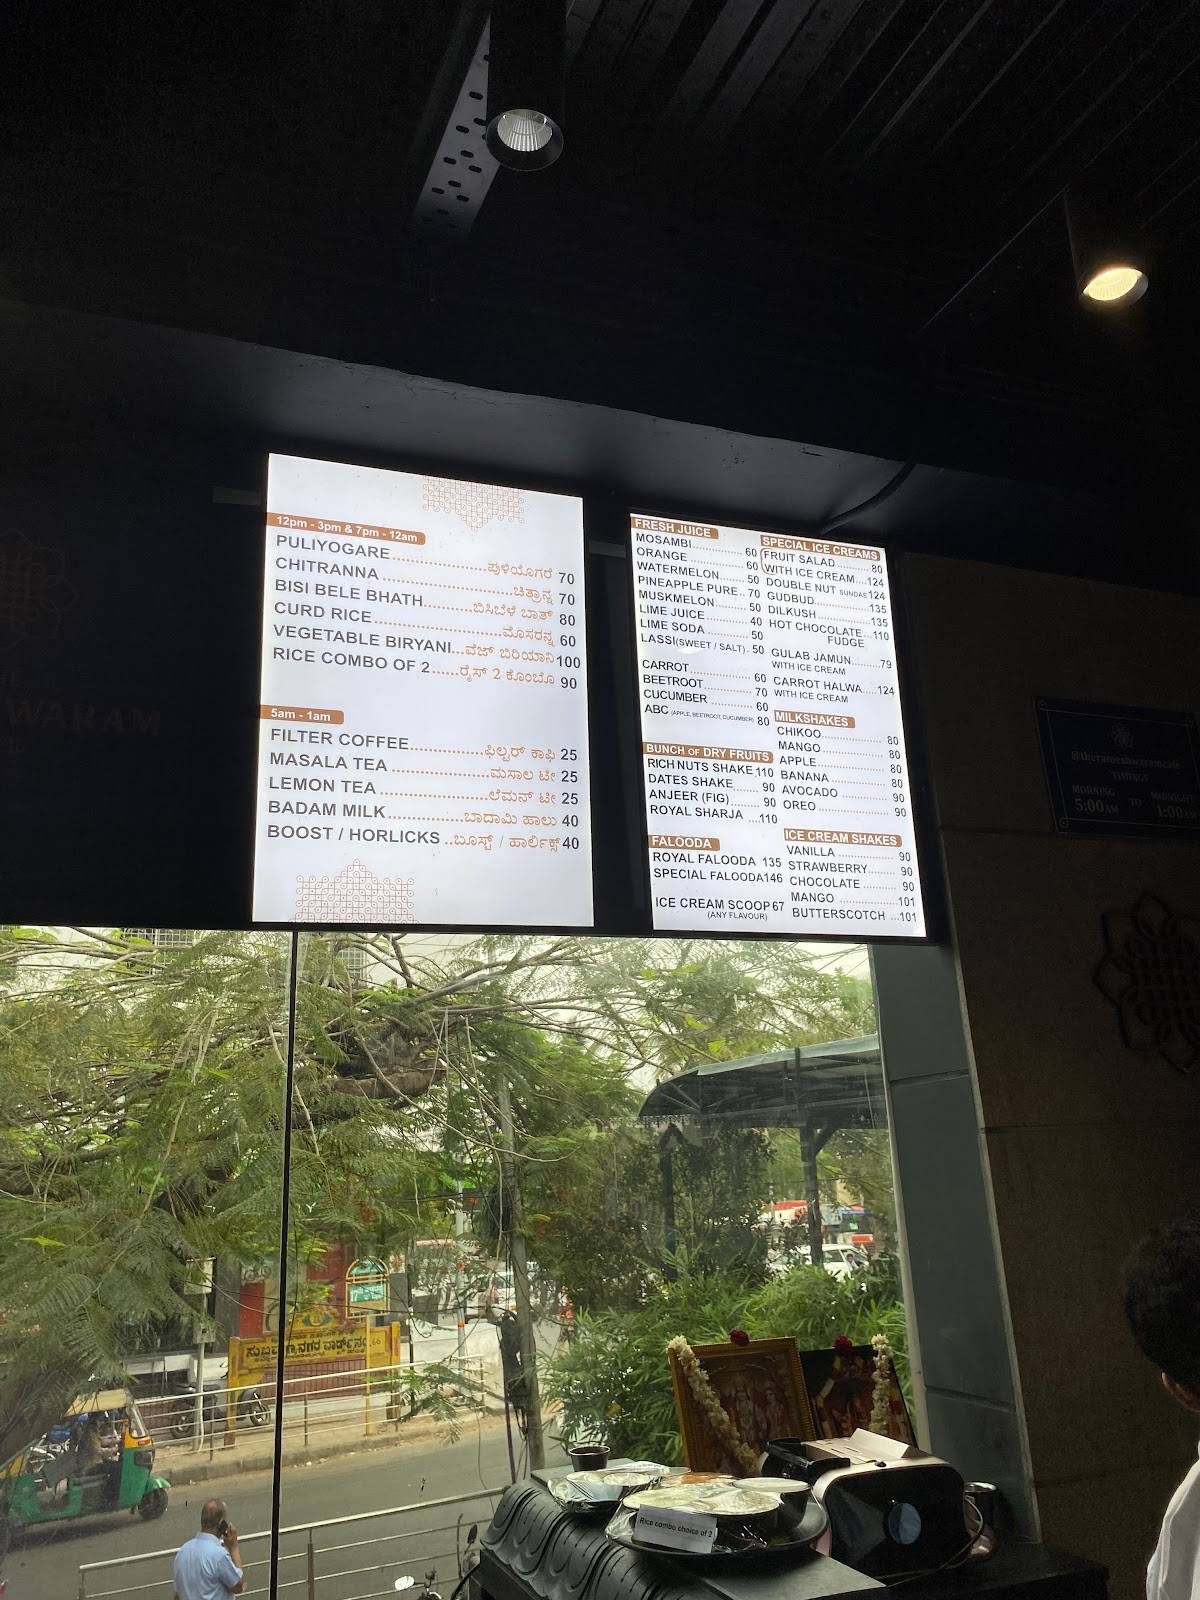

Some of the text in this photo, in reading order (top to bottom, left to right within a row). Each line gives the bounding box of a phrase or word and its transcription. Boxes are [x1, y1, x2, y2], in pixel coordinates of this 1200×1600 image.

[276, 515, 417, 542] 12pm 3pm 7pm 12am
[634, 518, 711, 537] FRESH JUICE
[635, 532, 692, 548] MOSAMBI
[636, 546, 687, 561] ORANGE
[762, 536, 877, 560] SPECIAL ICE CREAMS
[276, 534, 390, 559] PULIYOGARE
[558, 572, 574, 584] 70
[763, 550, 835, 567] FRUIT SALAD
[637, 560, 719, 579] WATERMELON
[764, 563, 855, 583] WITH ICE CREAM
[275, 556, 379, 579] CHITRANNA
[559, 592, 575, 605] 70
[638, 575, 738, 596] PINEAPPLE PURE
[765, 577, 837, 594] DOUBLE NUT
[274, 578, 308, 594] BISI
[315, 583, 360, 599] BELE
[366, 589, 423, 606] BHATH
[559, 613, 575, 626] 80
[638, 589, 714, 607] MUSKMELON
[767, 591, 814, 605] GUDBUD
[639, 603, 704, 619] LIME JUICE
[767, 605, 816, 619] DILKUSH
[273, 601, 325, 618] CURD
[331, 607, 371, 623] RICE
[560, 634, 576, 647] 60
[639, 618, 704, 634] LIME SODA
[768, 618, 862, 637] HOT CHOCOLATE
[272, 624, 379, 646] VEGETABLE
[385, 635, 451, 653] BIRYANI
[556, 655, 580, 668] 100
[719, 642, 746, 654] SALT)
[827, 635, 864, 648] FUDGE
[771, 647, 851, 664] GULAB JAMUN
[272, 646, 315, 662] RICE
[321, 651, 387, 669] COMBO
[393, 658, 415, 672] OF
[421, 661, 429, 673] 2
[560, 676, 577, 689] 90
[642, 659, 689, 672] CARROT
[771, 660, 845, 675] WITH ICE CREAM
[642, 673, 703, 688] BEETROOT
[773, 676, 862, 693] CARROT HALWA
[643, 688, 707, 703] CUCUMBER
[270, 708, 330, 721] 5am 1am
[644, 703, 669, 715] ABC
[775, 711, 848, 726] MILKSHAKES
[776, 726, 821, 738] CHIKOO
[270, 728, 332, 744] FILTER
[338, 733, 409, 750] COFFEE
[560, 748, 577, 761] 25
[646, 743, 684, 754] BUNCH
[703, 747, 726, 757] DRY
[729, 749, 769, 761] FRUITS
[778, 740, 820, 753] MANGO
[270, 752, 347, 769] MASALA
[352, 757, 388, 771] TEA
[560, 770, 578, 783] 25
[647, 758, 753, 774] RICH NUTS SHAKE
[779, 755, 816, 767] APPLE
[648, 773, 733, 788] DATES SHAKE
[780, 770, 829, 782] BANANA
[269, 776, 334, 792] LEMON
[340, 780, 376, 794] TEA
[561, 792, 578, 805] 25
[648, 789, 729, 805] ANJEER (FIG)
[781, 785, 838, 797] AVOCADO
[649, 804, 743, 819] ROYAL SHARJA
[782, 799, 816, 810] OREO
[268, 800, 336, 816] BADAM
[342, 804, 385, 818] MILK
[561, 814, 578, 827] 40
[267, 824, 333, 839] BOOST
[349, 828, 440, 844] HORLICKS
[562, 836, 579, 849] 40
[651, 836, 711, 848] FALOODA
[785, 830, 897, 845] ICE CREAM SHAKES
[786, 845, 835, 857] VANILLA
[652, 852, 756, 866] ROYAL FALOODA
[788, 860, 867, 873] STRAWBERRY
[653, 868, 763, 882] SPECIAL FALOODA
[789, 876, 860, 888] CHOCOLATE
[655, 897, 770, 911] ICE CREAM SCOOP
[790, 891, 834, 903] MANGO
[707, 911, 768, 920] (ANY FLAVOUR)
[792, 907, 885, 920] BUTTERSCOTCH
[640, 1517, 653, 1526] Rice
[655, 1521, 676, 1530] combo
[678, 1525, 699, 1535] choice
